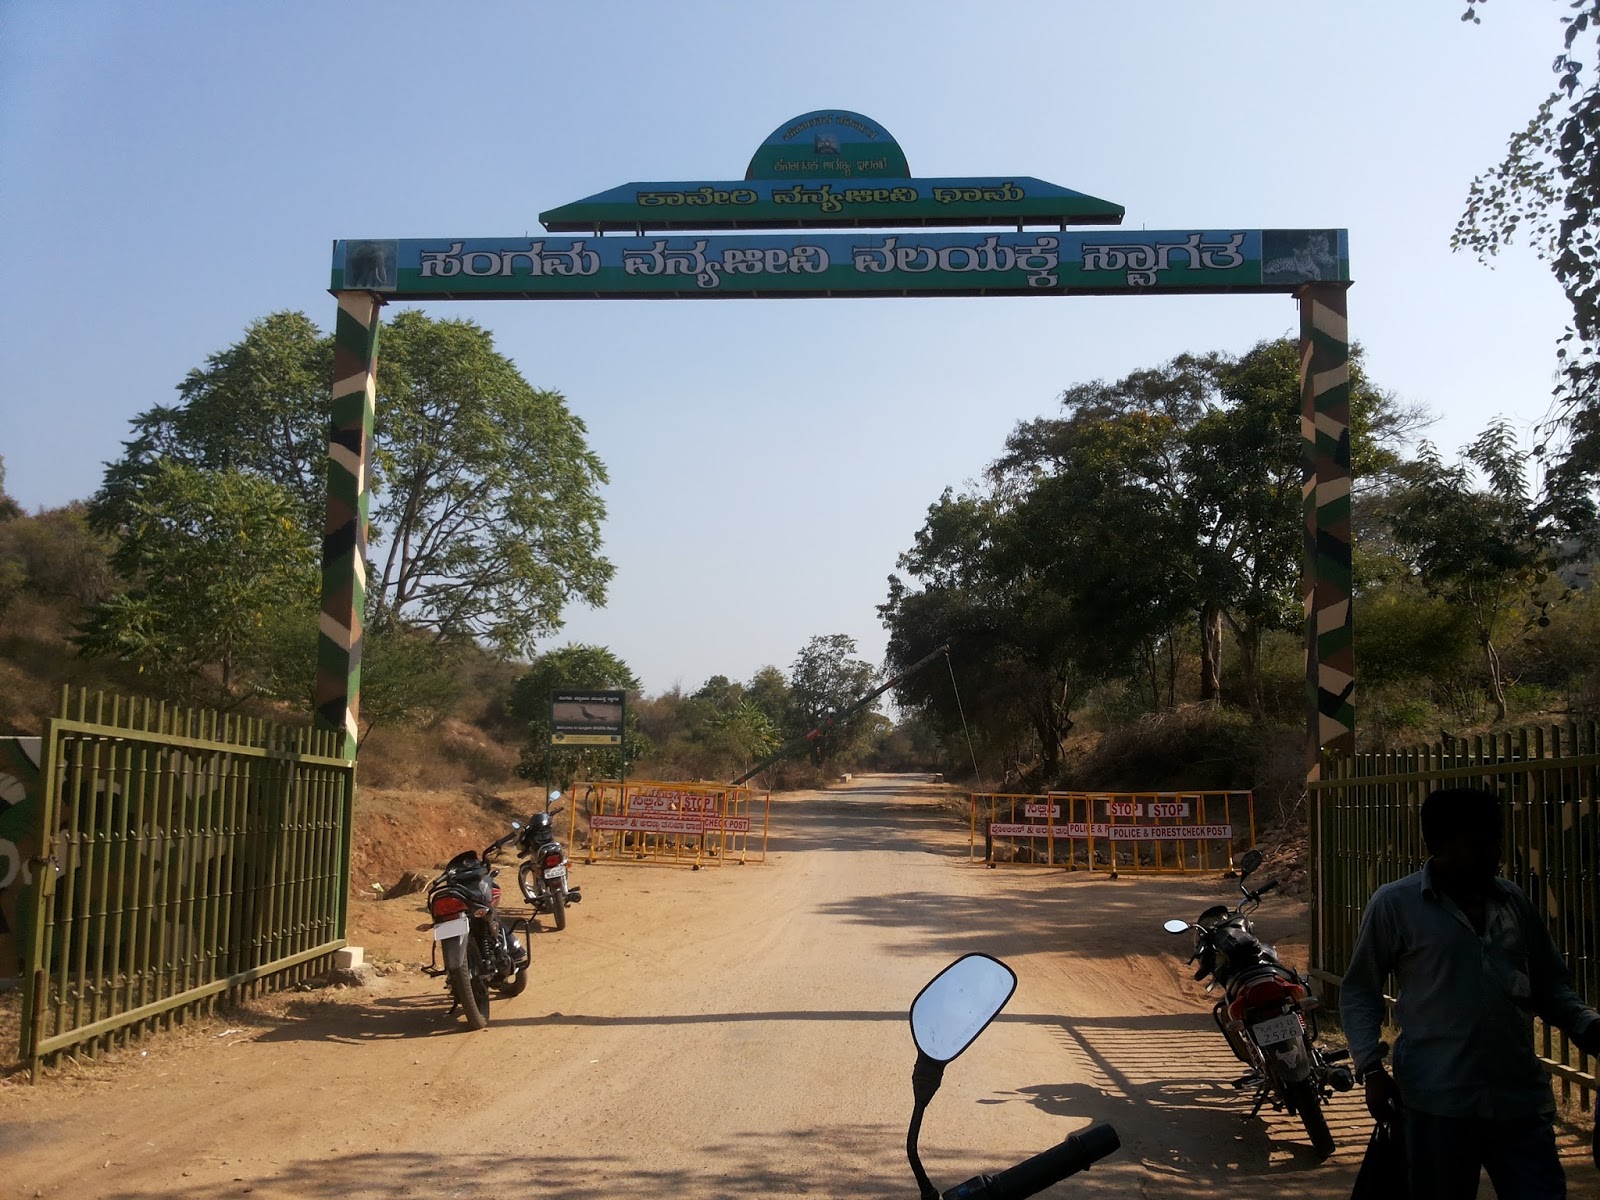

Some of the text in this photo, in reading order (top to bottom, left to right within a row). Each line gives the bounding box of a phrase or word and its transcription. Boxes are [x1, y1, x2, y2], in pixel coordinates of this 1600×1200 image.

[636, 182, 1025, 213] ಕಾವೇರಿ ವನ್ಯಜೀವಿ ಧಾಮ
[419, 232, 1246, 289] ಸಂಗಮ ವನ್ಯಜೀವಿ ವಲಯಕ್ಕೆ ಸ್ವಾಗತ
[1154, 804, 1184, 816] STOP
[729, 820, 748, 830] POST
[1113, 828, 1141, 839] POLICE
[1143, 828, 1149, 838] &
[1151, 827, 1181, 838] FOREST
[1182, 826, 1206, 837] CHECK
[1206, 826, 1227, 836] POST
[1263, 1027, 1296, 1043] 2576
